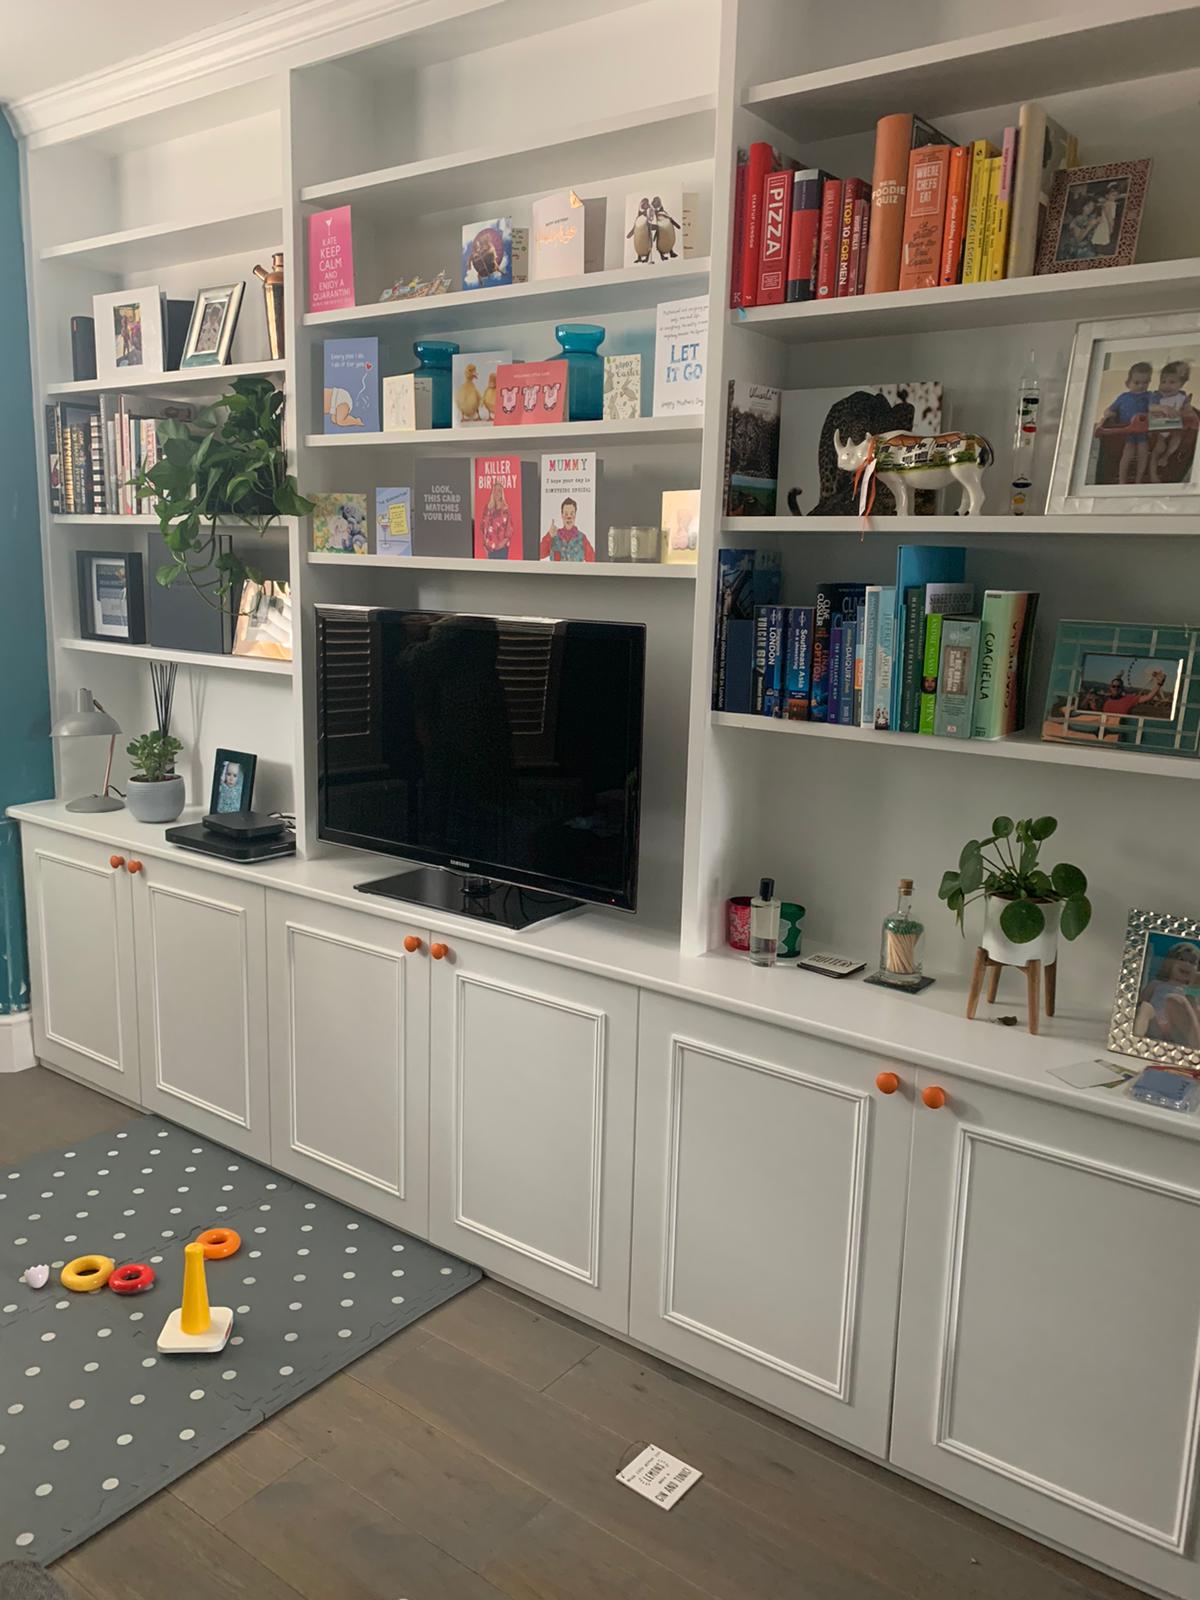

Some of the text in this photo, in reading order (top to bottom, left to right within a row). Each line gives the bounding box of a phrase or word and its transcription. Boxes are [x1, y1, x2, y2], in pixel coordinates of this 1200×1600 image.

[916, 165, 939, 178] WHERE
[872, 186, 906, 199] FOODIE
[917, 179, 938, 191] CHEFS
[876, 196, 898, 207] QUIZ
[920, 191, 932, 203] EAT
[766, 187, 784, 256] PIZZA
[844, 203, 853, 225] TOP
[843, 226, 851, 238] 10
[320, 245, 341, 259] KEEP
[841, 239, 849, 262] FOR
[319, 258, 343, 272] CALM
[325, 271, 338, 280] AND
[839, 262, 847, 286] MEN
[319, 280, 339, 291] ENJOY
[671, 343, 700, 363] LET
[666, 363, 703, 382] IT GO
[485, 460, 511, 474] KILLER
[549, 459, 587, 471] MUMMY
[431, 485, 453, 494] LOOK,
[479, 474, 517, 488] BIRTHDAY
[424, 494, 461, 502] THIS CARD
[426, 503, 460, 512] MATCHES
[423, 512, 462, 521] YOUR HAIR
[816, 593, 825, 626] CUSSLER
[823, 599, 831, 619] CLIVE
[756, 617, 767, 674] VULCAN 607
[768, 627, 777, 665] LONDON
[799, 628, 808, 669] Southeast
[812, 643, 822, 682] OPTION
[821, 651, 829, 676] FINAL
[979, 633, 995, 700] COACHELLA
[798, 671, 806, 688] Asia
[926, 694, 935, 722] OPEN
[643, 1462, 665, 1481] LEMONS
[655, 1491, 668, 1502] GIN
[664, 1481, 679, 1493] AND
